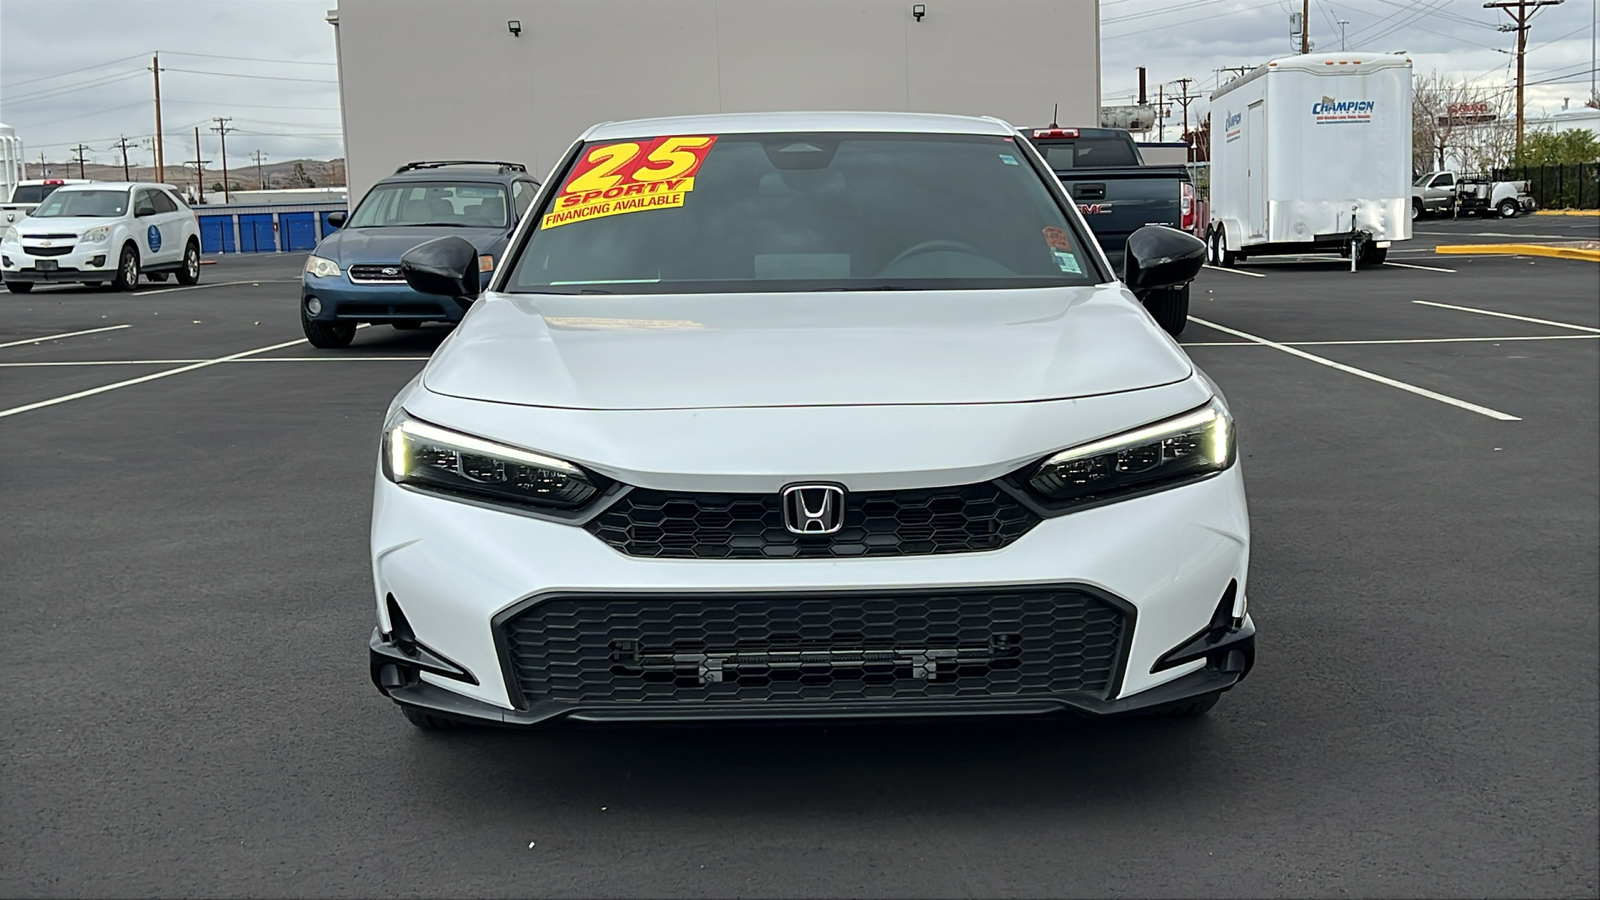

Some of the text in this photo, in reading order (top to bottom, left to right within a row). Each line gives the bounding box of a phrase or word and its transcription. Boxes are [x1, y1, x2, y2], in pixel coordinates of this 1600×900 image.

[1312, 101, 1375, 114] CHAMPION
[566, 137, 712, 194] 25
[561, 179, 687, 208] SPORTY
[545, 194, 680, 226] FINANCING AVAILABLE
